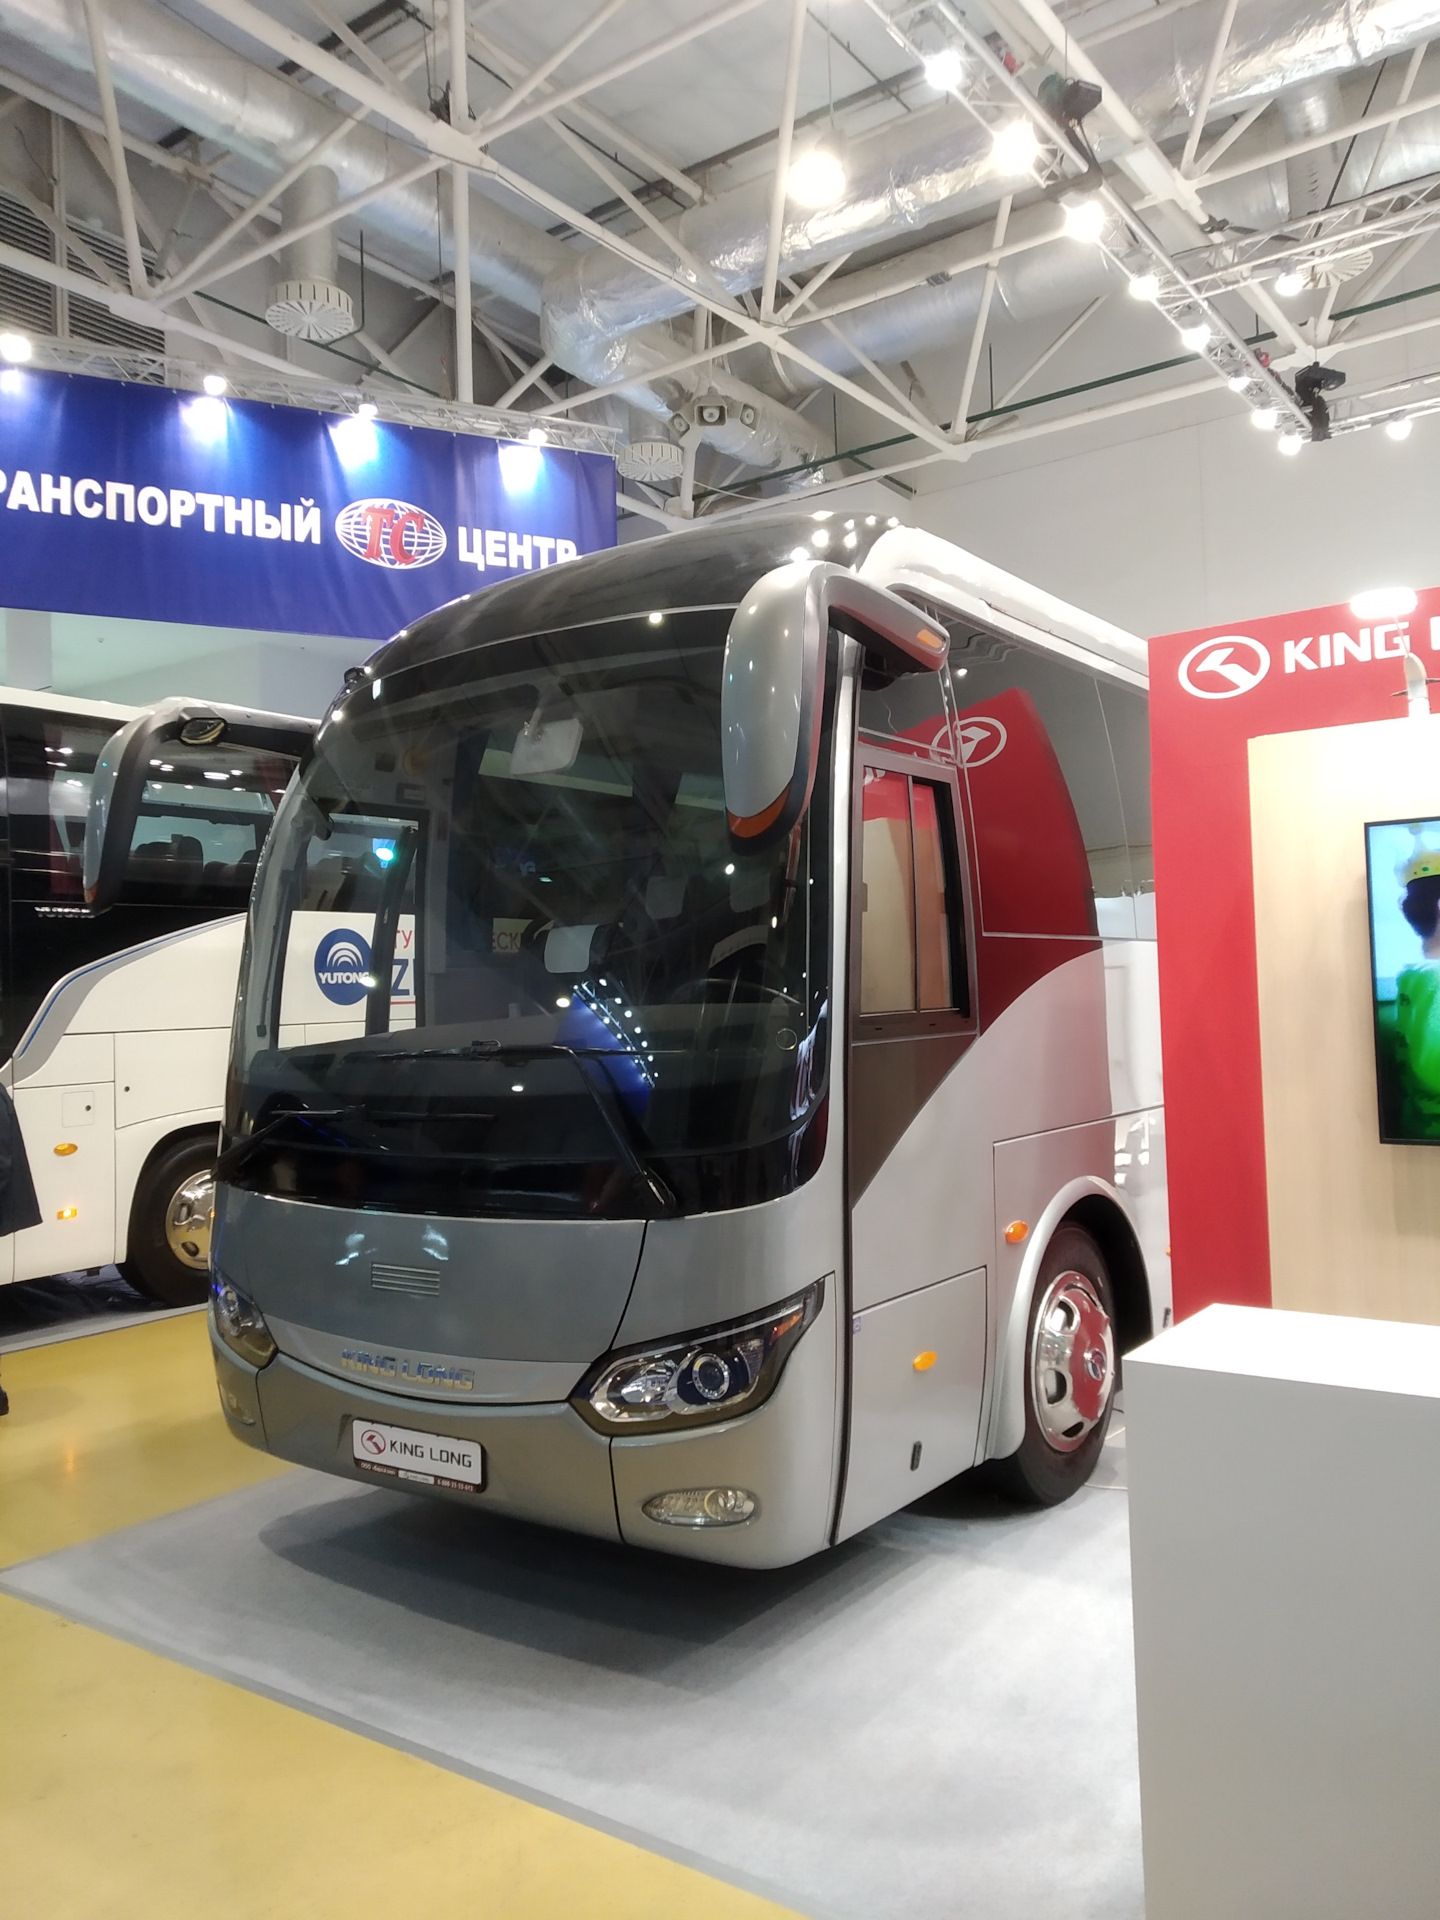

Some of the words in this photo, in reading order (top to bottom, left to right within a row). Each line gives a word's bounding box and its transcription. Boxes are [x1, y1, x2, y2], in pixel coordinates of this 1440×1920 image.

[0, 469, 321, 545] АНСПОРТНЫЙ
[458, 526, 578, 572] ЦЕНТР
[1283, 621, 1411, 674] KING
[341, 1348, 396, 1377] KING
[401, 1360, 475, 1391] LONG
[389, 1440, 424, 1459] KING
[429, 1447, 473, 1468] LONG
